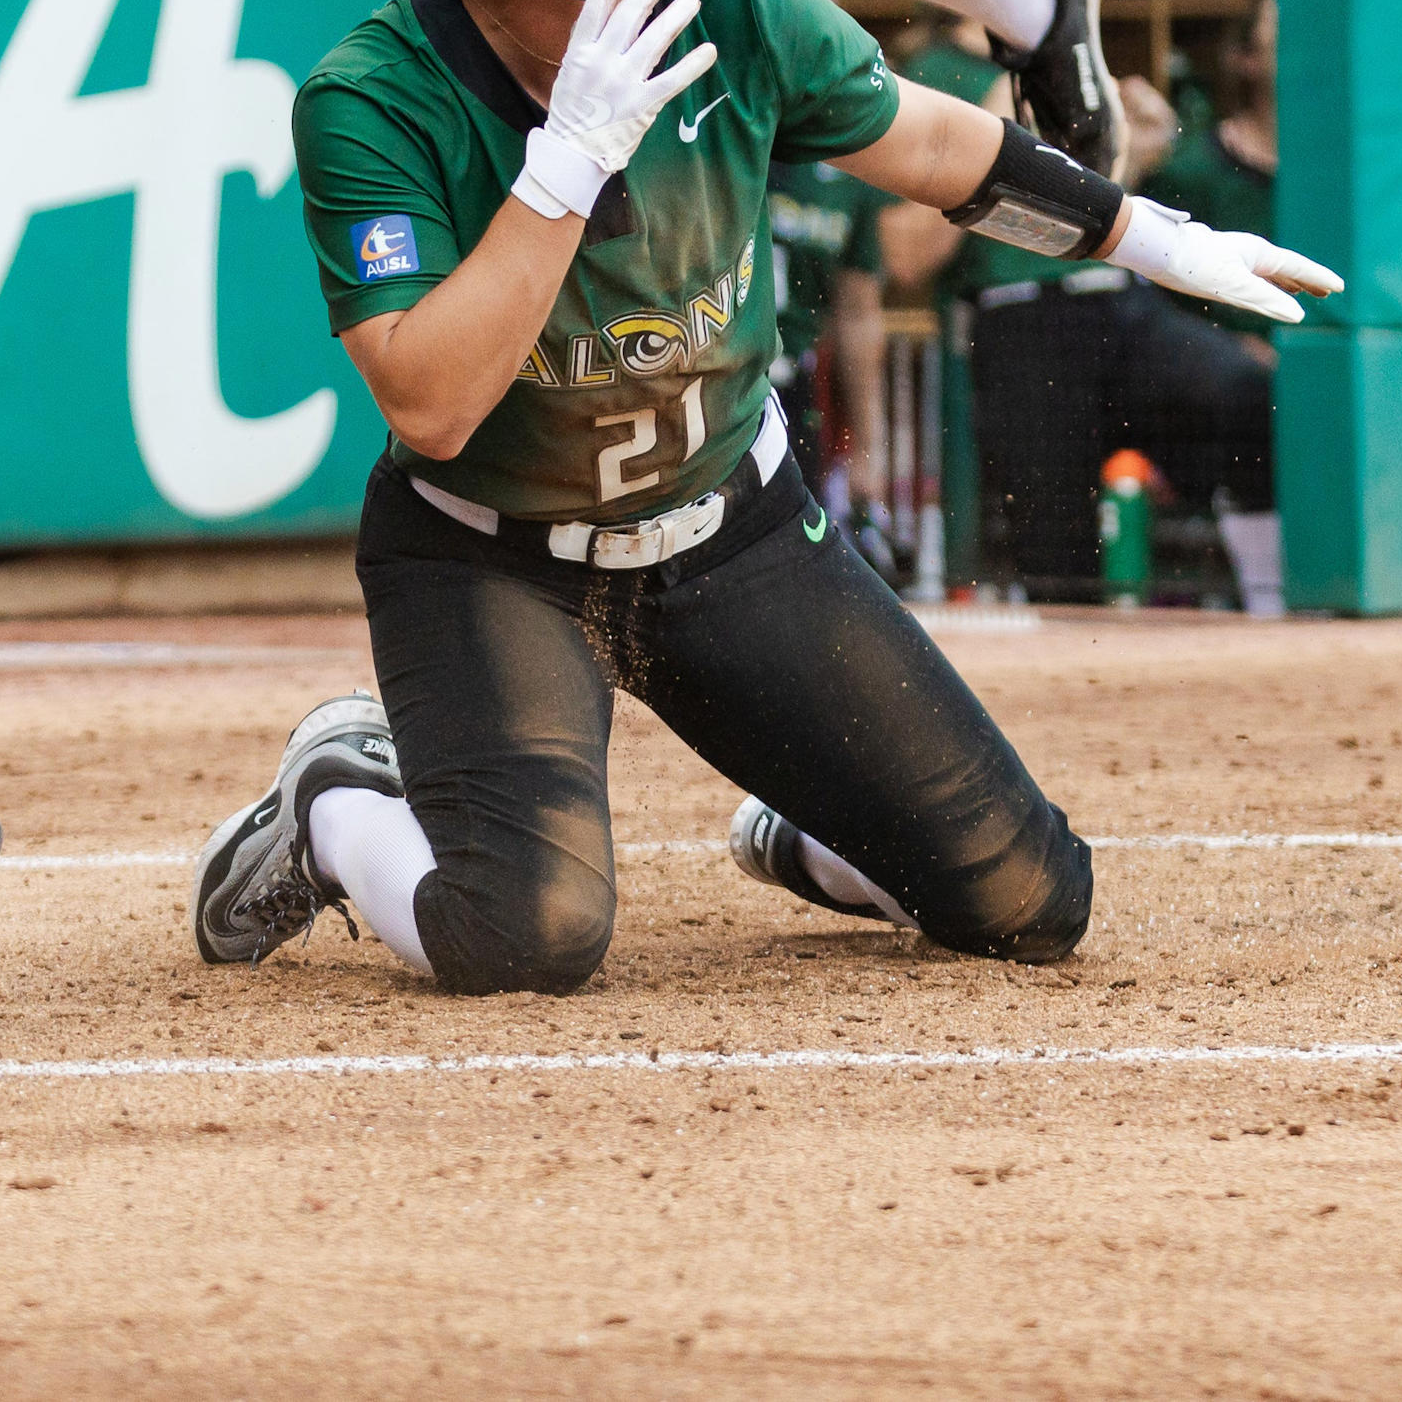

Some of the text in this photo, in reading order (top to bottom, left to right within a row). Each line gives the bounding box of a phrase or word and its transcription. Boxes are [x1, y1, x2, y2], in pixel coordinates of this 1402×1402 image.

[366, 255, 411, 278] AUSL
[516, 238, 754, 387] ALONS
[595, 376, 706, 503] 21
